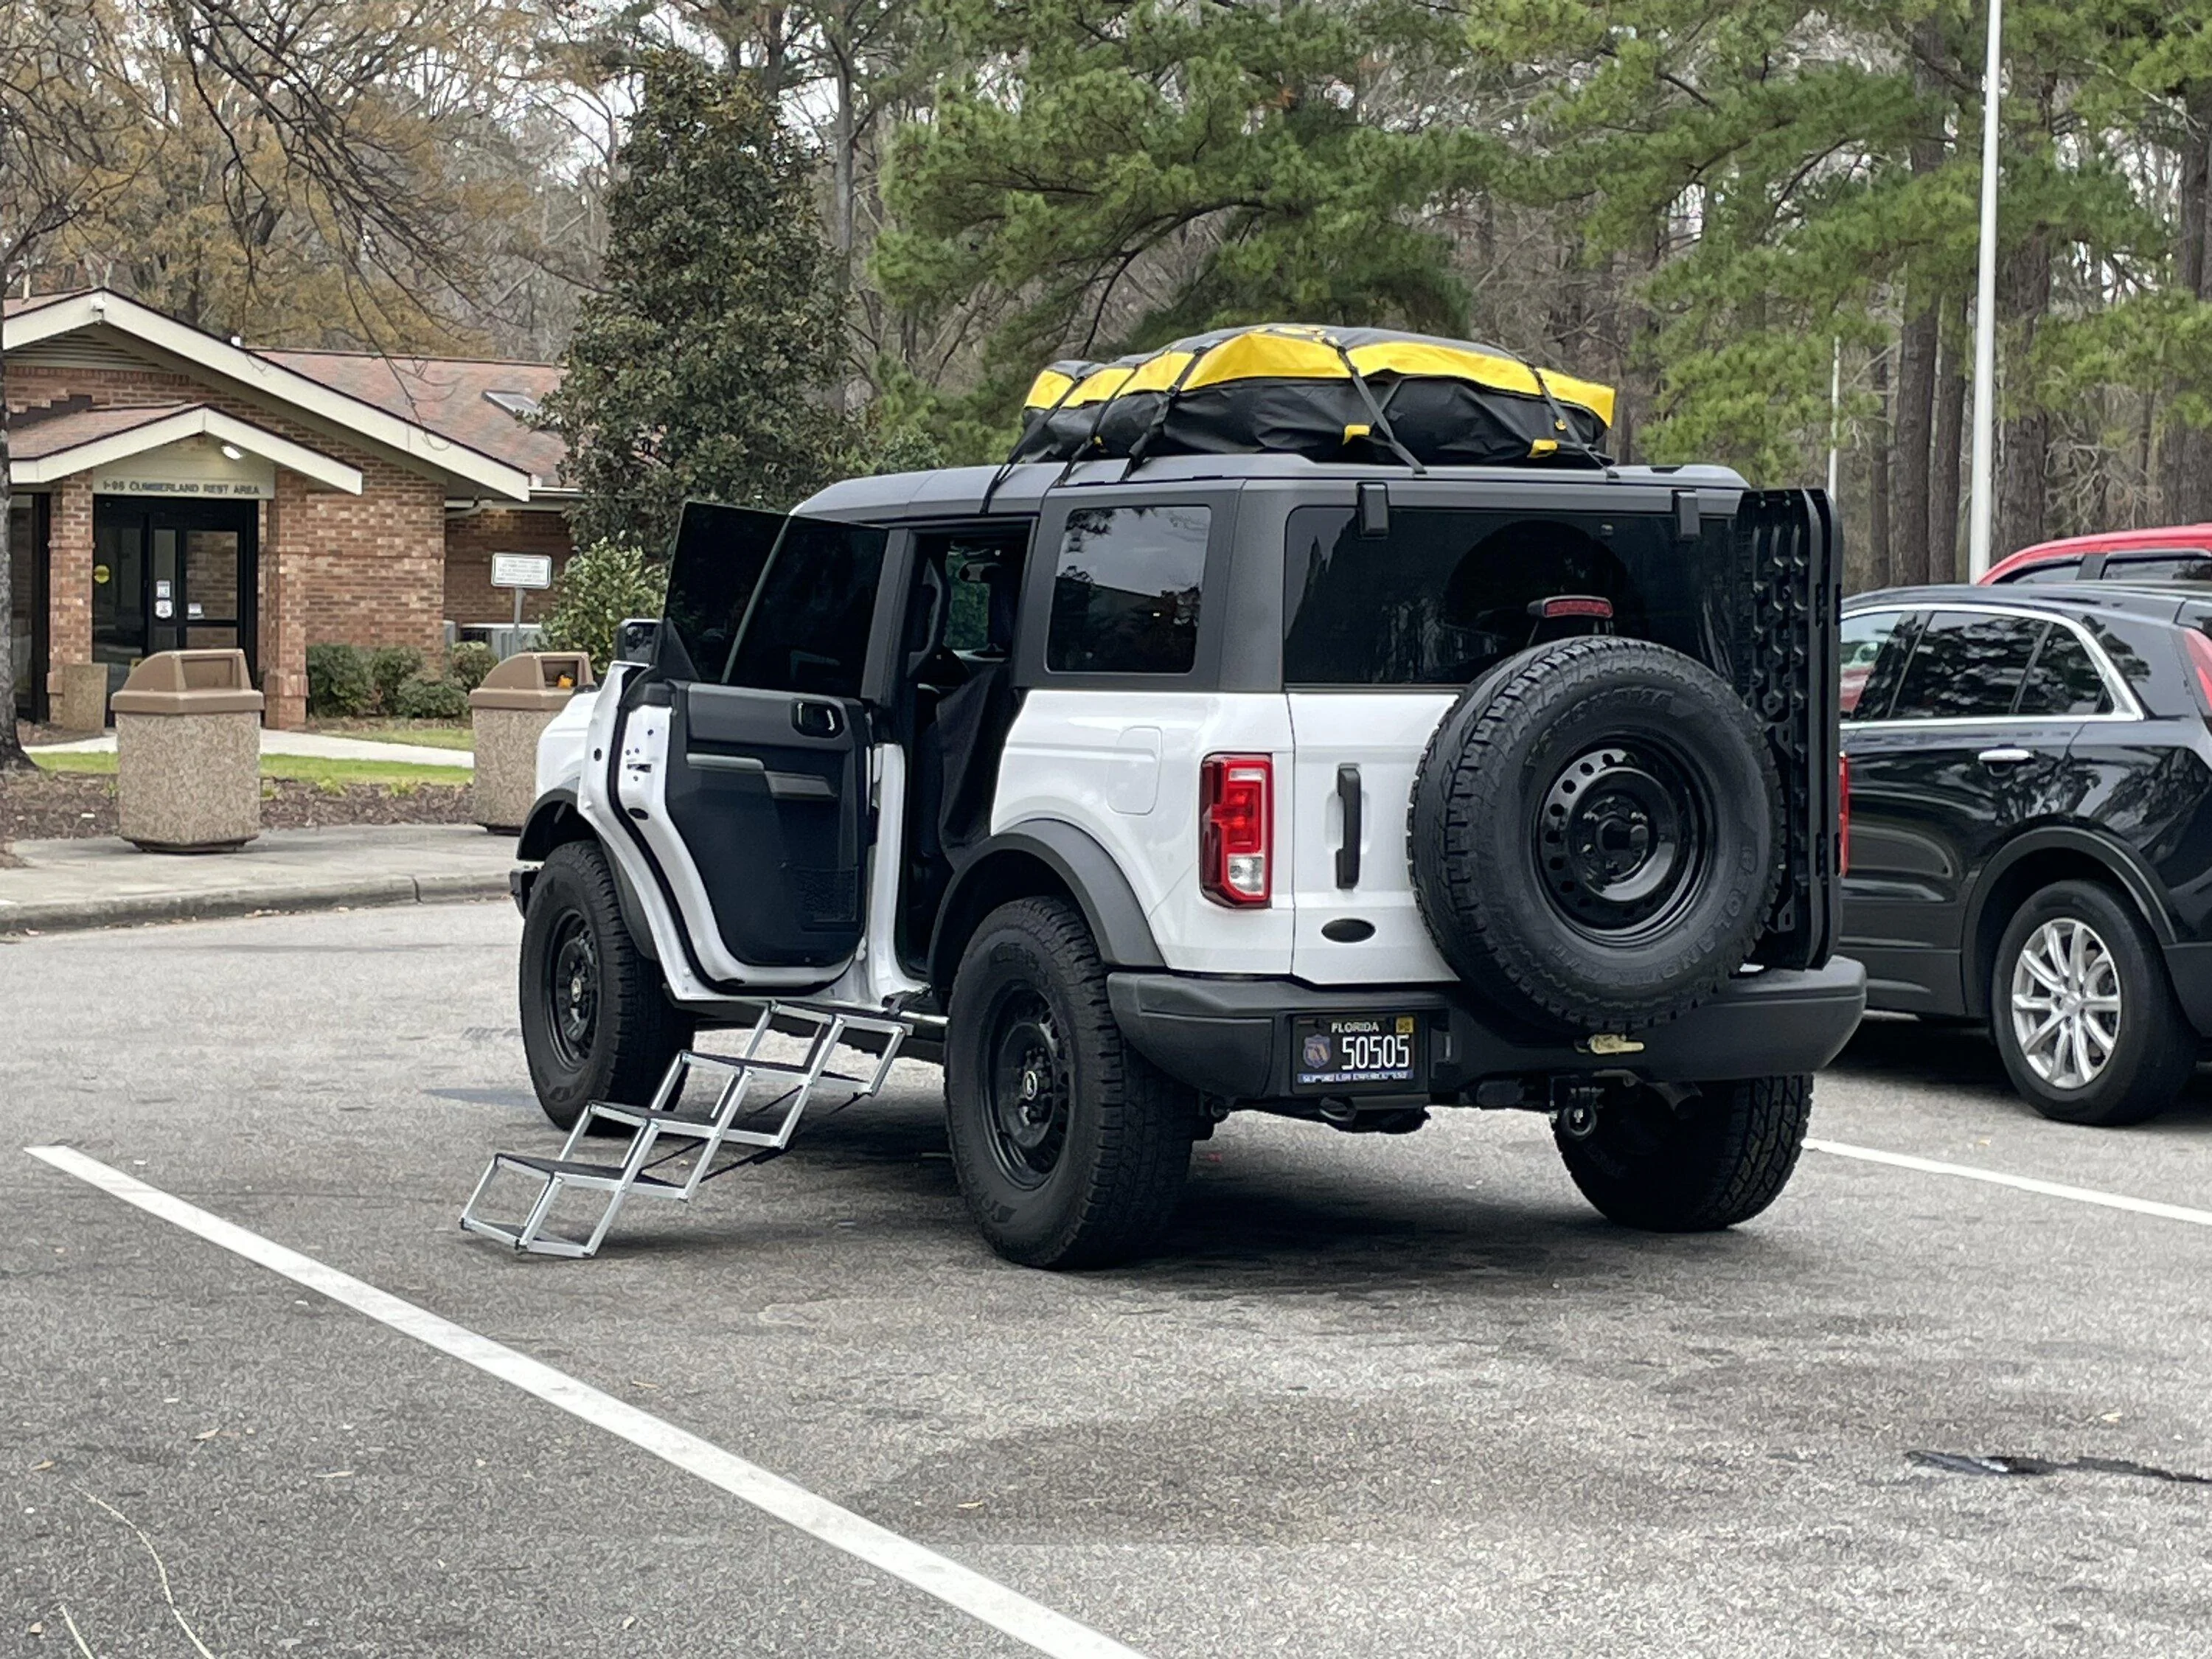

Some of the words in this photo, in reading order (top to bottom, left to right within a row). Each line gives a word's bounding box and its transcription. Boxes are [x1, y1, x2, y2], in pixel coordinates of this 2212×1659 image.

[128, 481, 199, 493] CUMBERLAND
[203, 483, 229, 494] REST
[233, 484, 260, 495] AREA
[1331, 1021, 1380, 1034] FLORIDA
[1341, 1034, 1410, 1071] 50505
